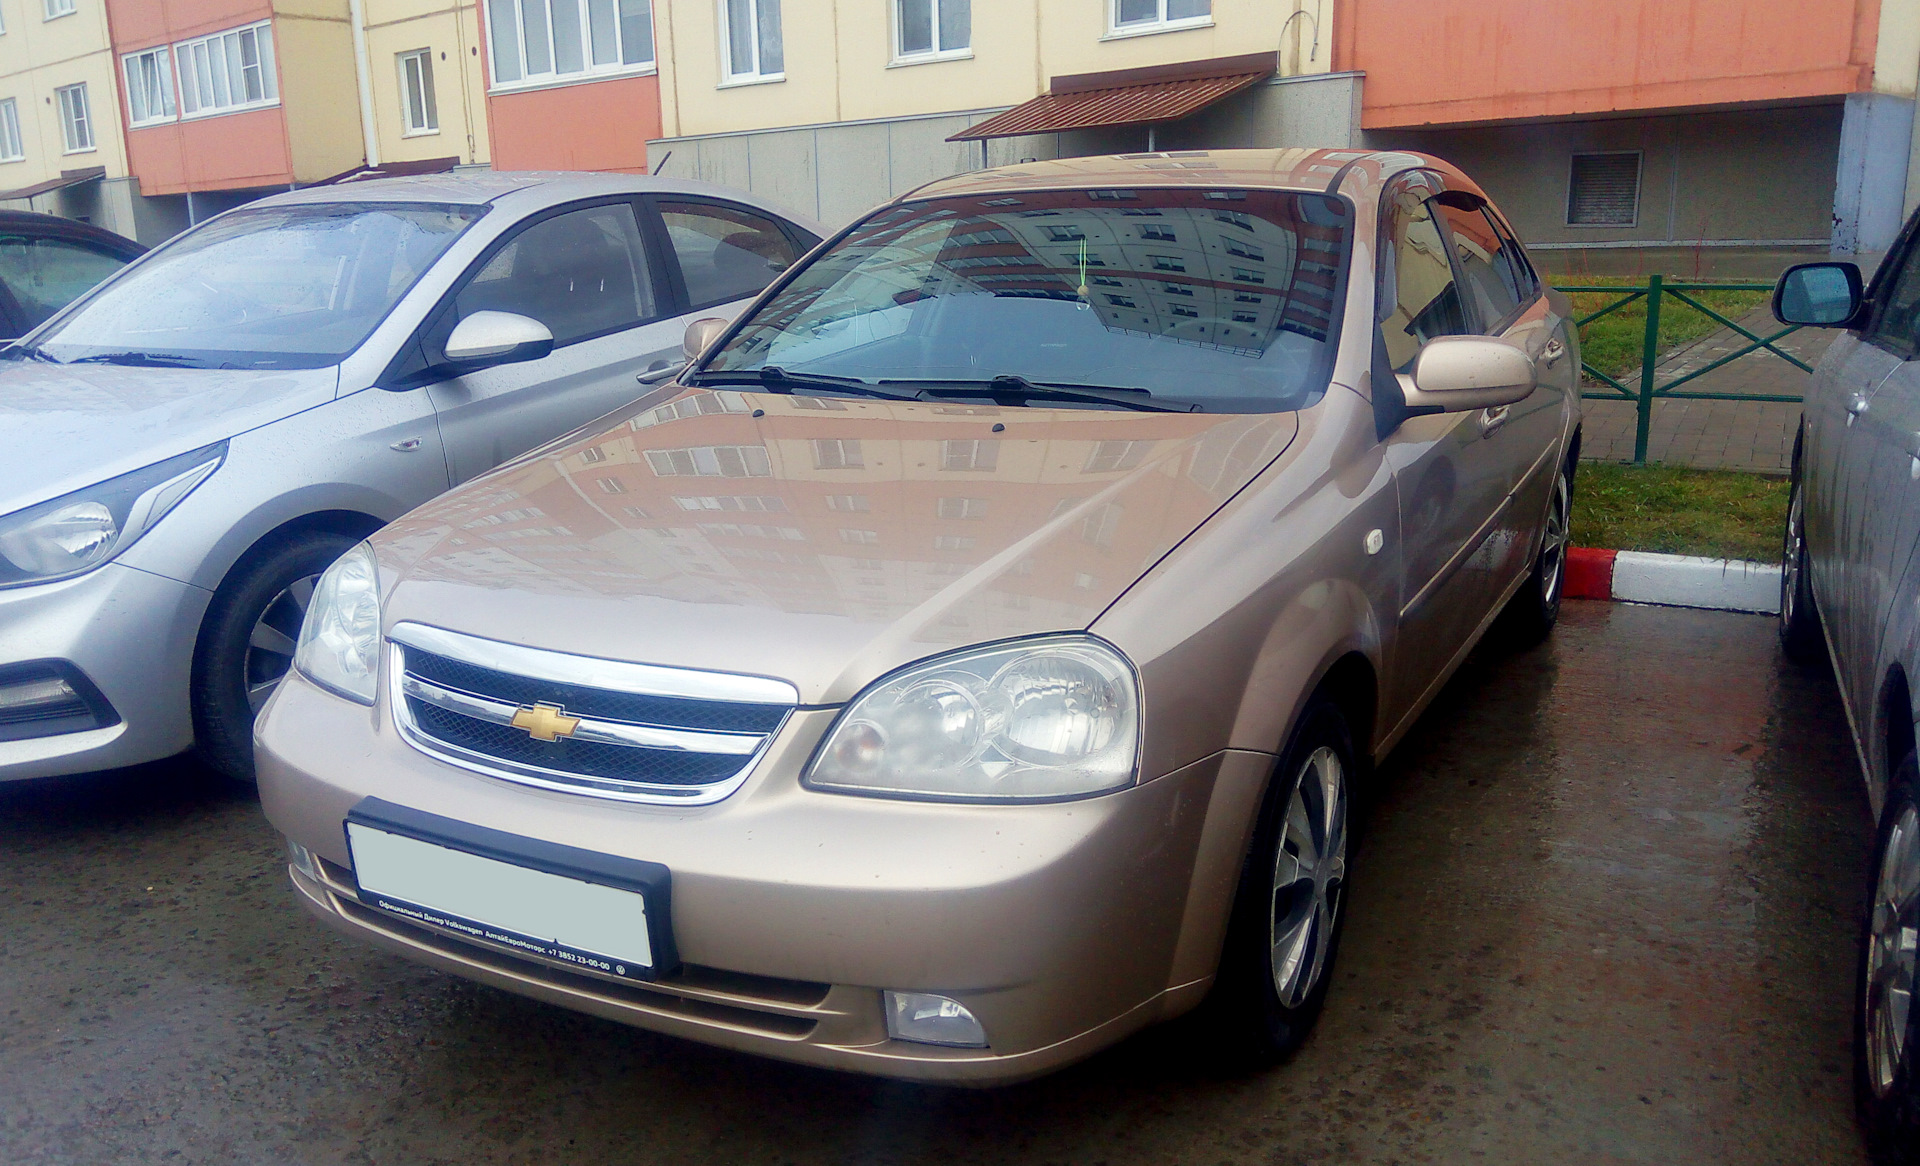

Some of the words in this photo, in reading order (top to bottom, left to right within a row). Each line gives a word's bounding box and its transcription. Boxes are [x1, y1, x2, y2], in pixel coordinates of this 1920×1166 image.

[378, 899, 424, 920] Официальный
[423, 913, 444, 926] Дилер
[444, 918, 484, 936] Volkswagen
[548, 949, 557, 957] +7
[558, 950, 577, 961] 3852
[577, 955, 611, 971] 23-00-00
